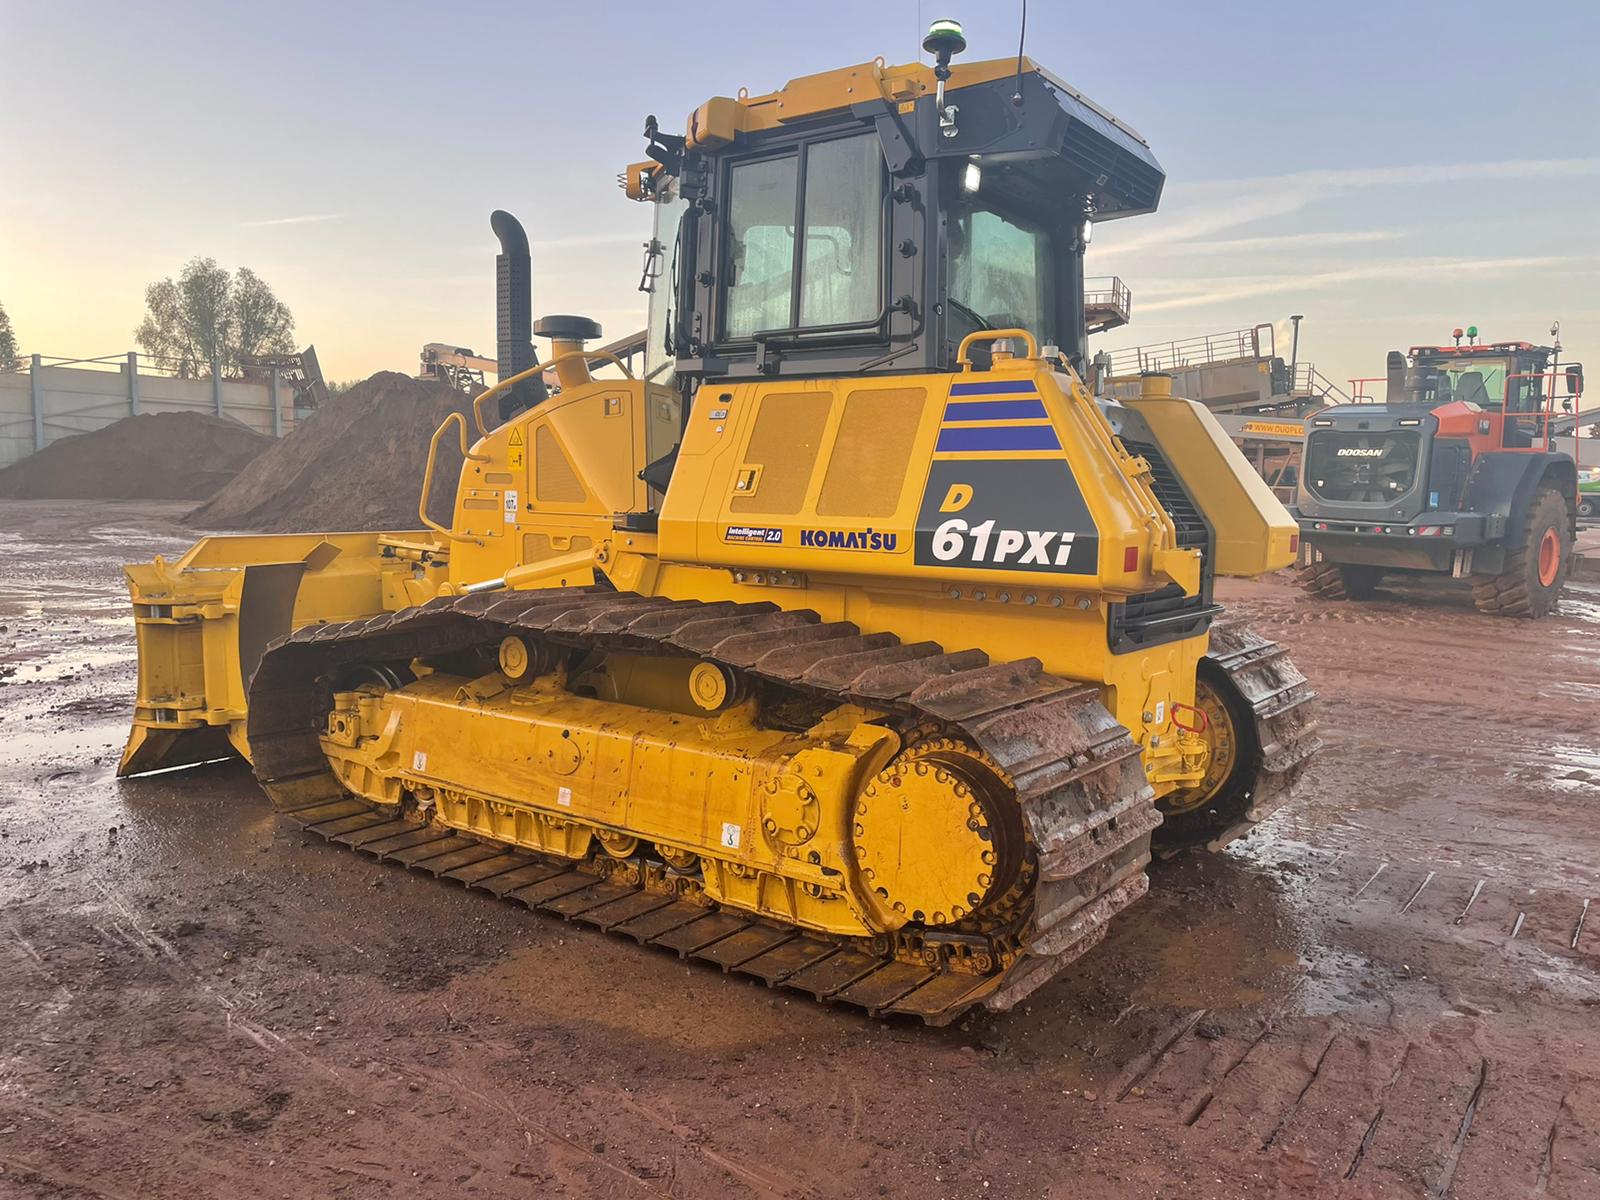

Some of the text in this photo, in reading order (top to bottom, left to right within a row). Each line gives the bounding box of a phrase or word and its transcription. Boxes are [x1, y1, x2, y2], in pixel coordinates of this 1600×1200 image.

[939, 484, 974, 512] D
[767, 531, 781, 541] 2.0
[801, 528, 896, 551] KOMATSU
